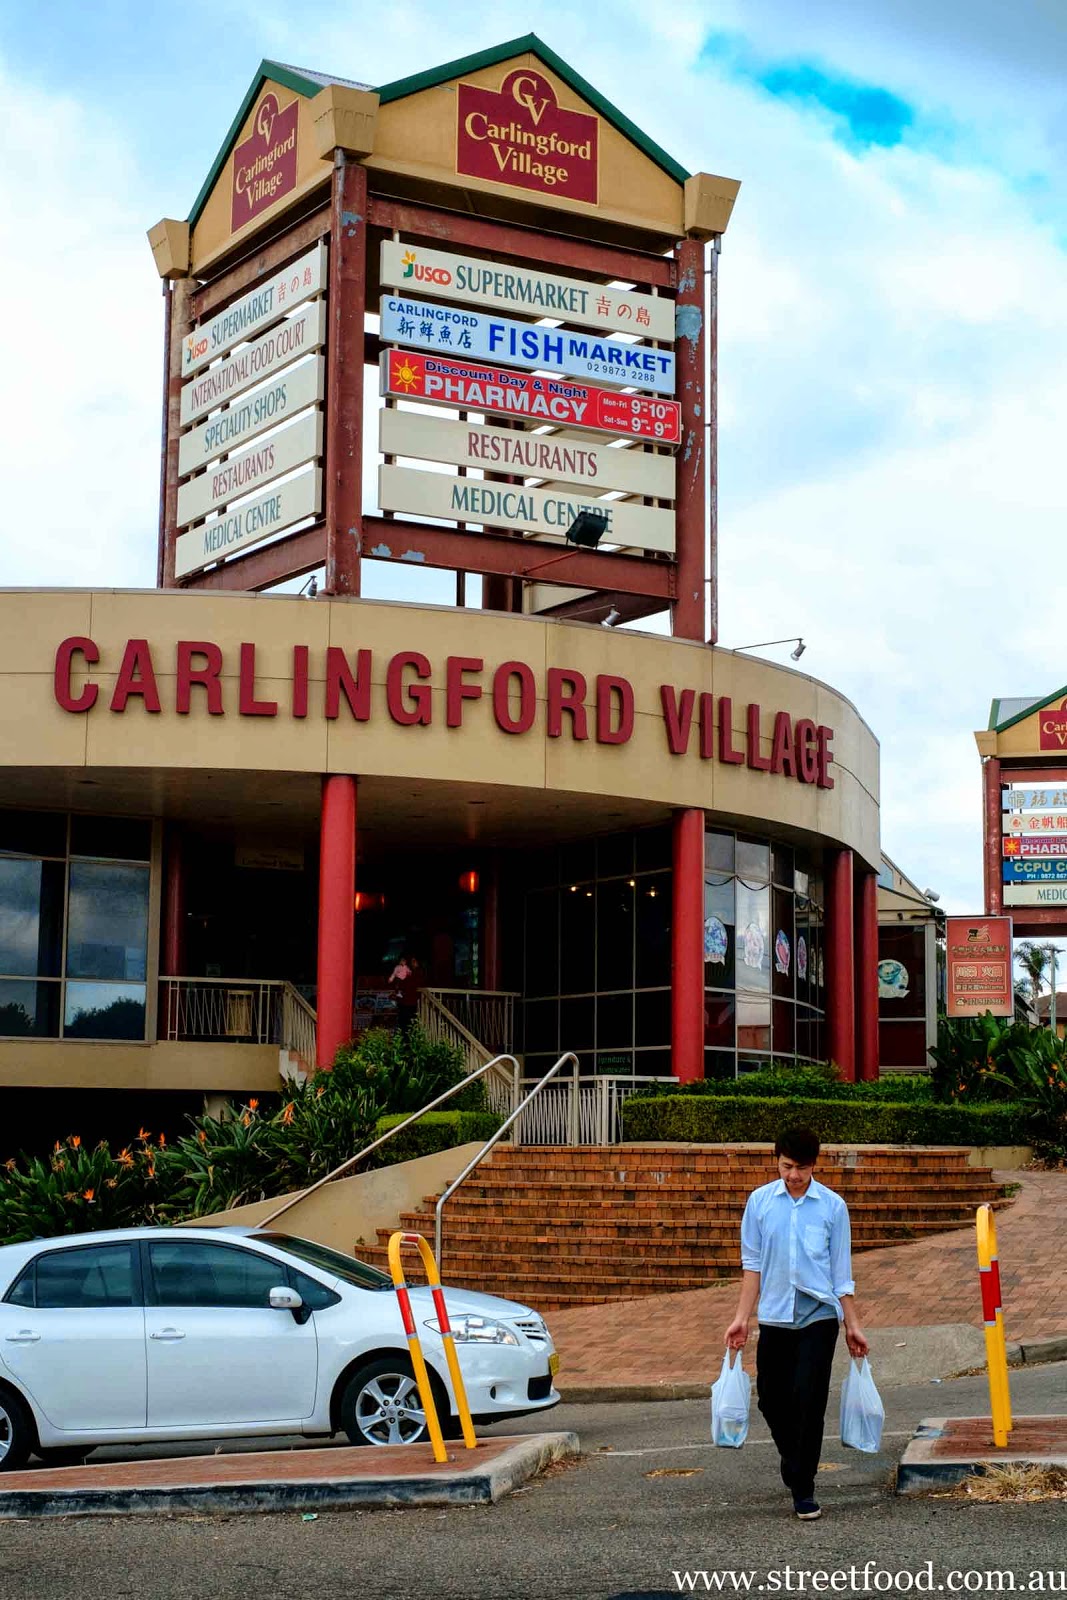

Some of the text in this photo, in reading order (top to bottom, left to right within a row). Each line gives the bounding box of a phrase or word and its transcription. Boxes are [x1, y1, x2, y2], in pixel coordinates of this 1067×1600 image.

[464, 112, 591, 160] Carlingford
[235, 127, 295, 194] Carlingford
[489, 142, 568, 185] Village
[246, 171, 283, 210] Village
[456, 265, 589, 315] SUPERMARKET
[595, 295, 651, 327] 吉の島
[211, 286, 275, 349] SUPERMARKET
[388, 301, 478, 328] CARLINGFORD
[191, 318, 306, 411] INTERNATIONAL FOOD COURT
[489, 324, 672, 374] FISH MARKET
[425, 360, 588, 399] Discount Day & Night
[602, 365, 626, 377] 9873
[632, 371, 655, 382] 2288
[205, 384, 287, 453] SPECIALITY SHOPS
[425, 376, 588, 421] PHARMACY
[212, 445, 275, 499] RESTAURANTS
[468, 432, 597, 477] RESTAURANTS
[203, 494, 282, 555] MEDICAL CENTRE
[451, 485, 613, 533] MEDICAL CENE
[54, 636, 835, 790] CARLINGFORD VILLAGE
[1014, 862, 1052, 872] CCPU
